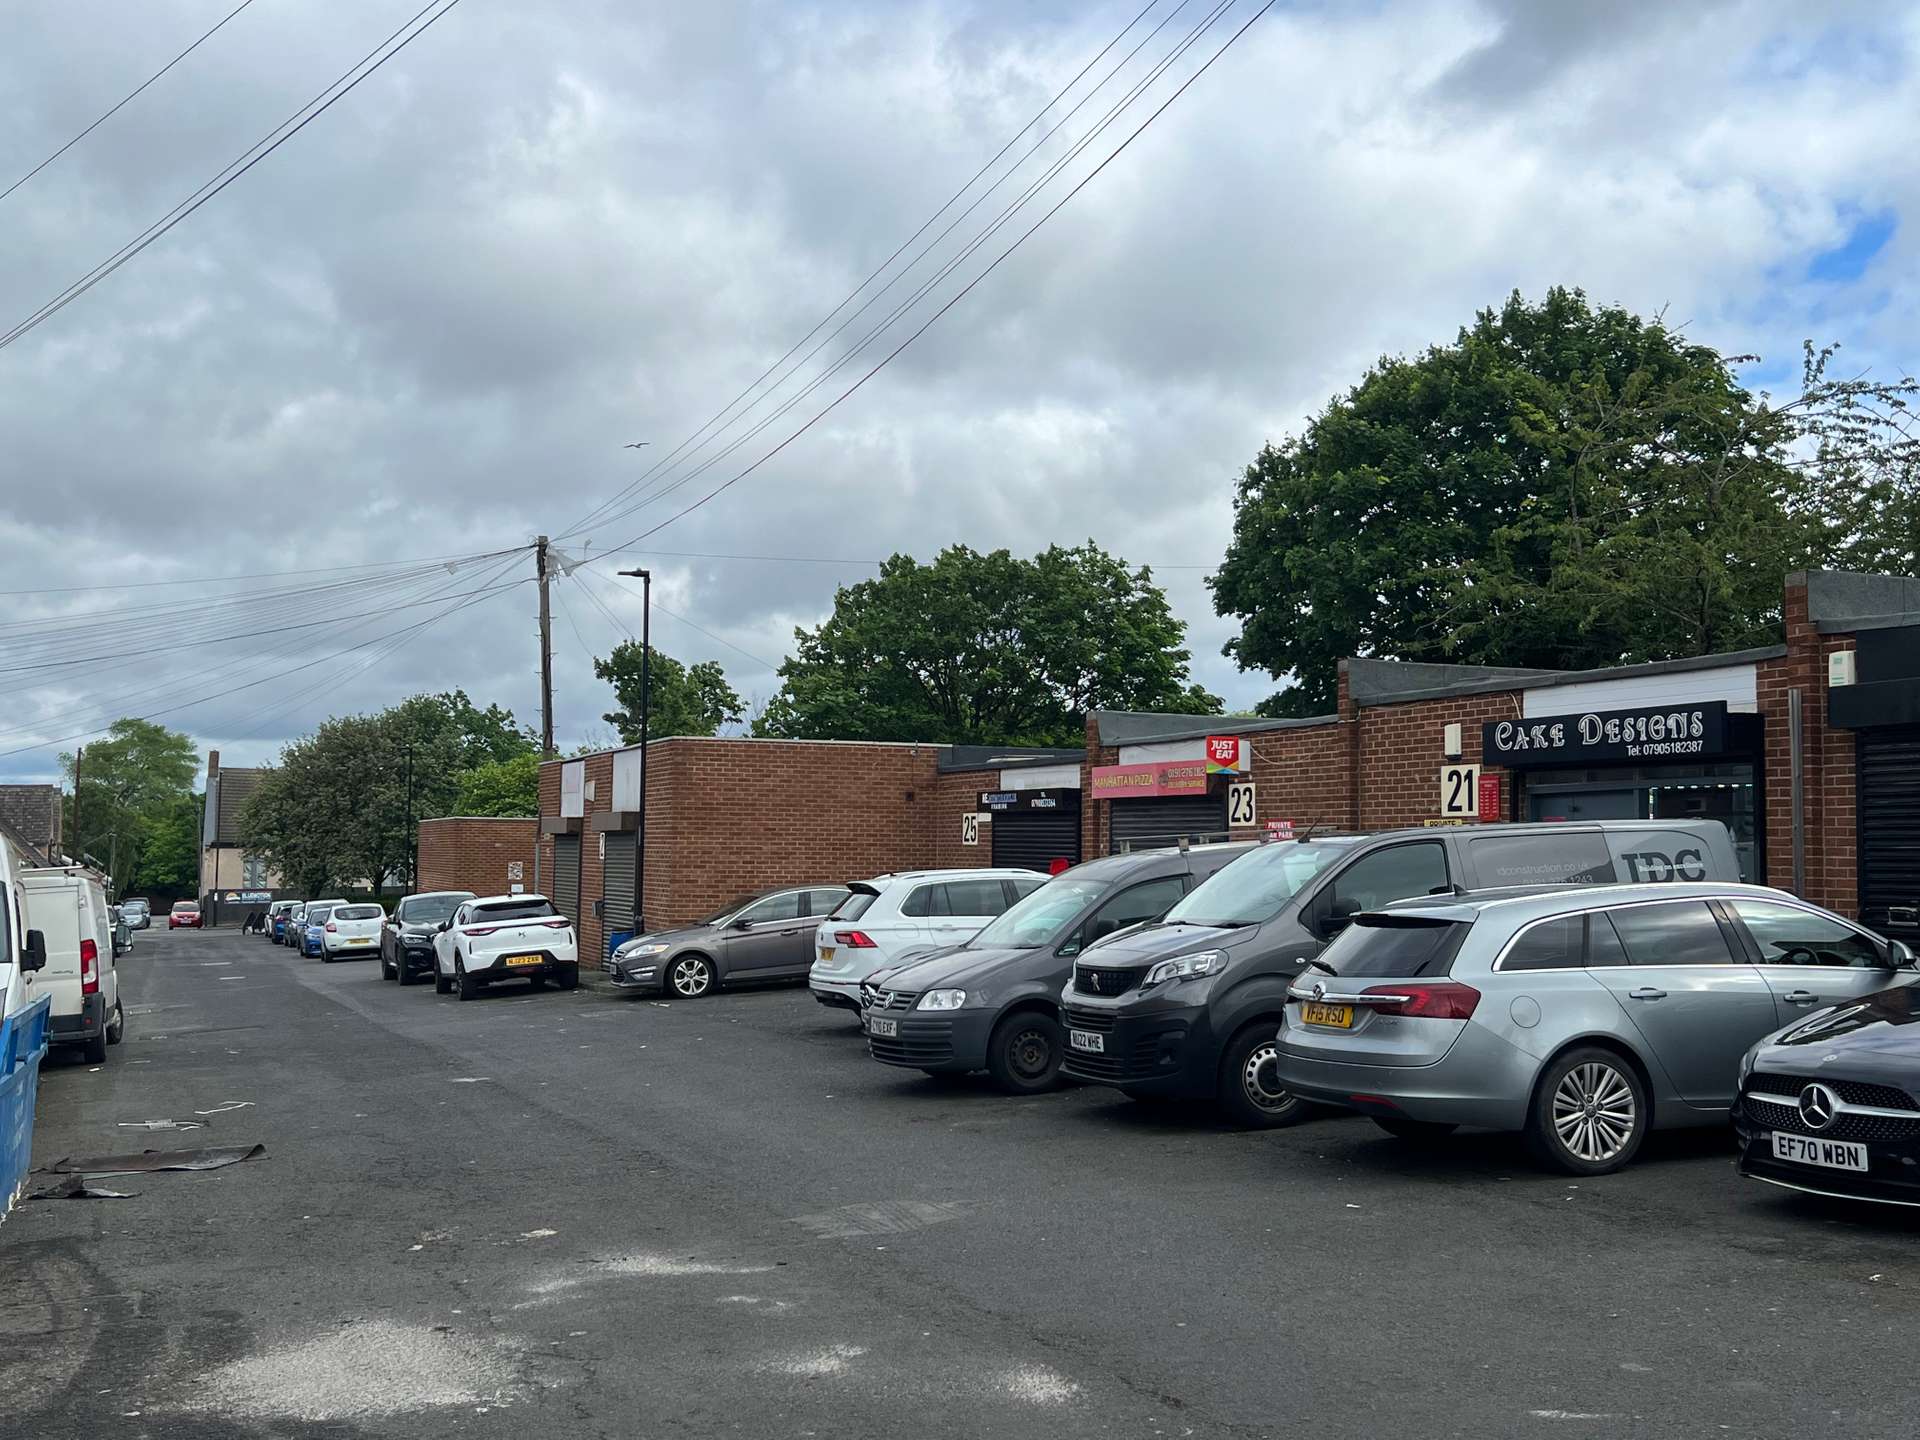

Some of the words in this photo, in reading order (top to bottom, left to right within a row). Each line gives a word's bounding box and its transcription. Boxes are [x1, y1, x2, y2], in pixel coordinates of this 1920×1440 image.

[1211, 740, 1234, 750] JUST
[1626, 745, 1642, 757] Tel:
[1643, 741, 1703, 756] 07905182387
[1216, 750, 1234, 759] EAT
[1095, 775, 1134, 788] MANHATTAN
[1135, 774, 1153, 786] PIZZA
[1447, 769, 1473, 812] 21
[1231, 787, 1253, 822] 23
[964, 816, 976, 842] 25
[1267, 821, 1291, 829] PRIVATE
[1325, 1006, 1345, 1023] RSO
[1778, 1136, 1818, 1161] EF70
[1822, 1143, 1860, 1167] WBN
